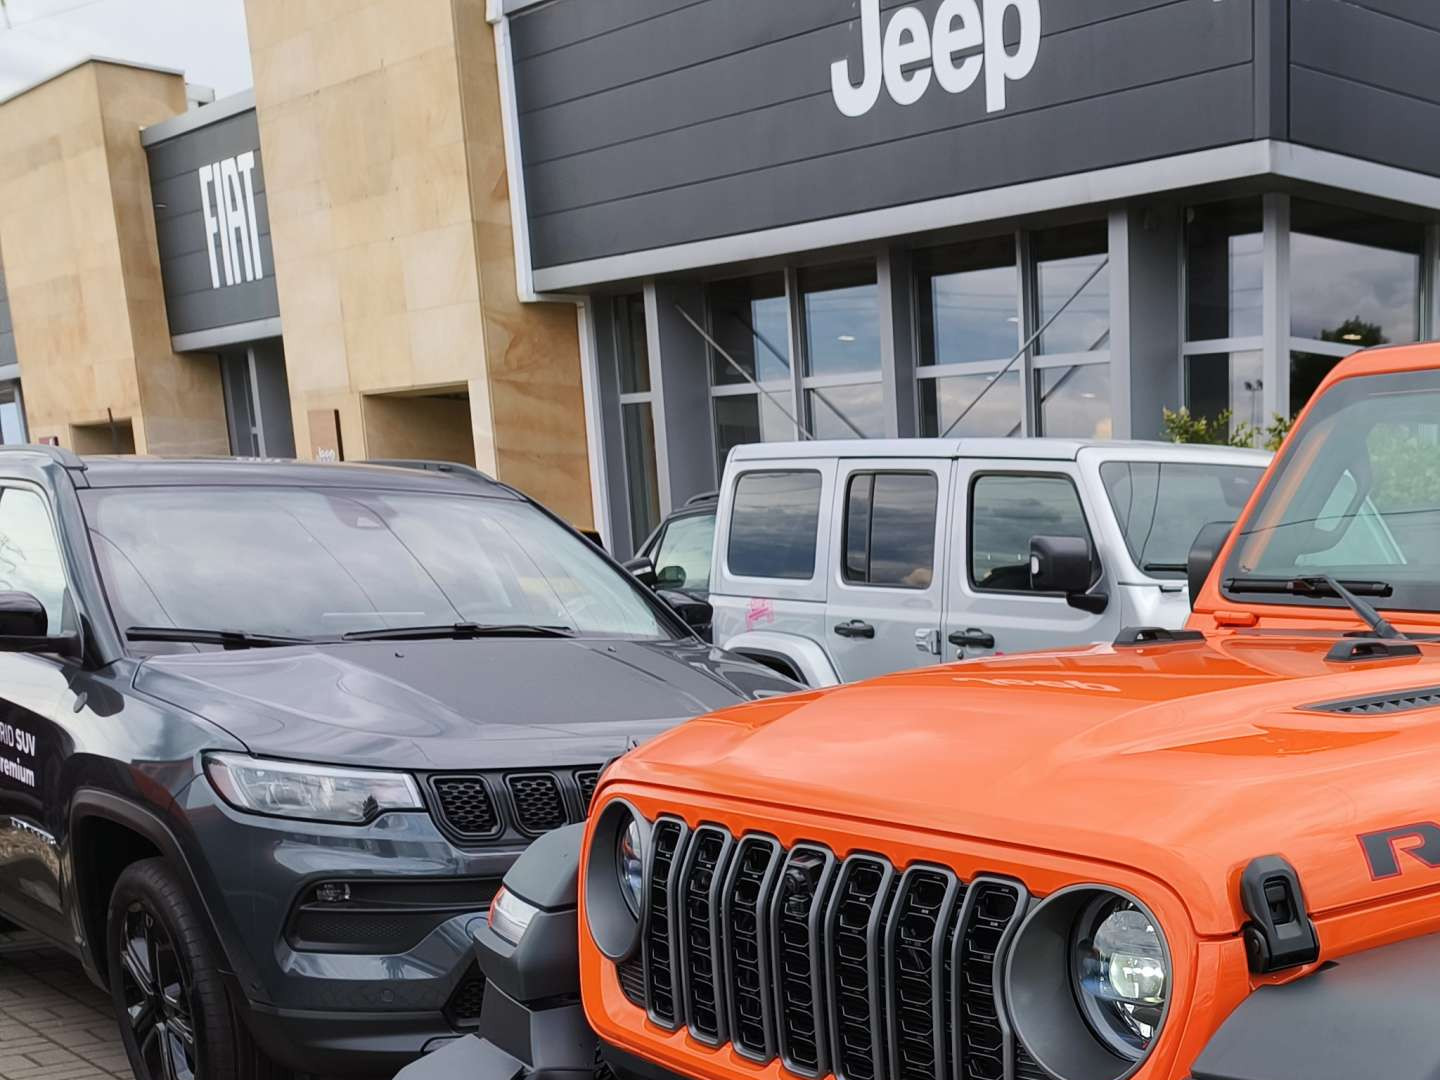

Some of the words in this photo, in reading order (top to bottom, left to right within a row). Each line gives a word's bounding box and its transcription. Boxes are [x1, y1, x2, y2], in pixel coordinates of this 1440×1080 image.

[831, 0, 1042, 117] Jeep
[199, 150, 263, 289] FIAT
[0, 756, 35, 787] remium
[15, 728, 36, 757] SUV
